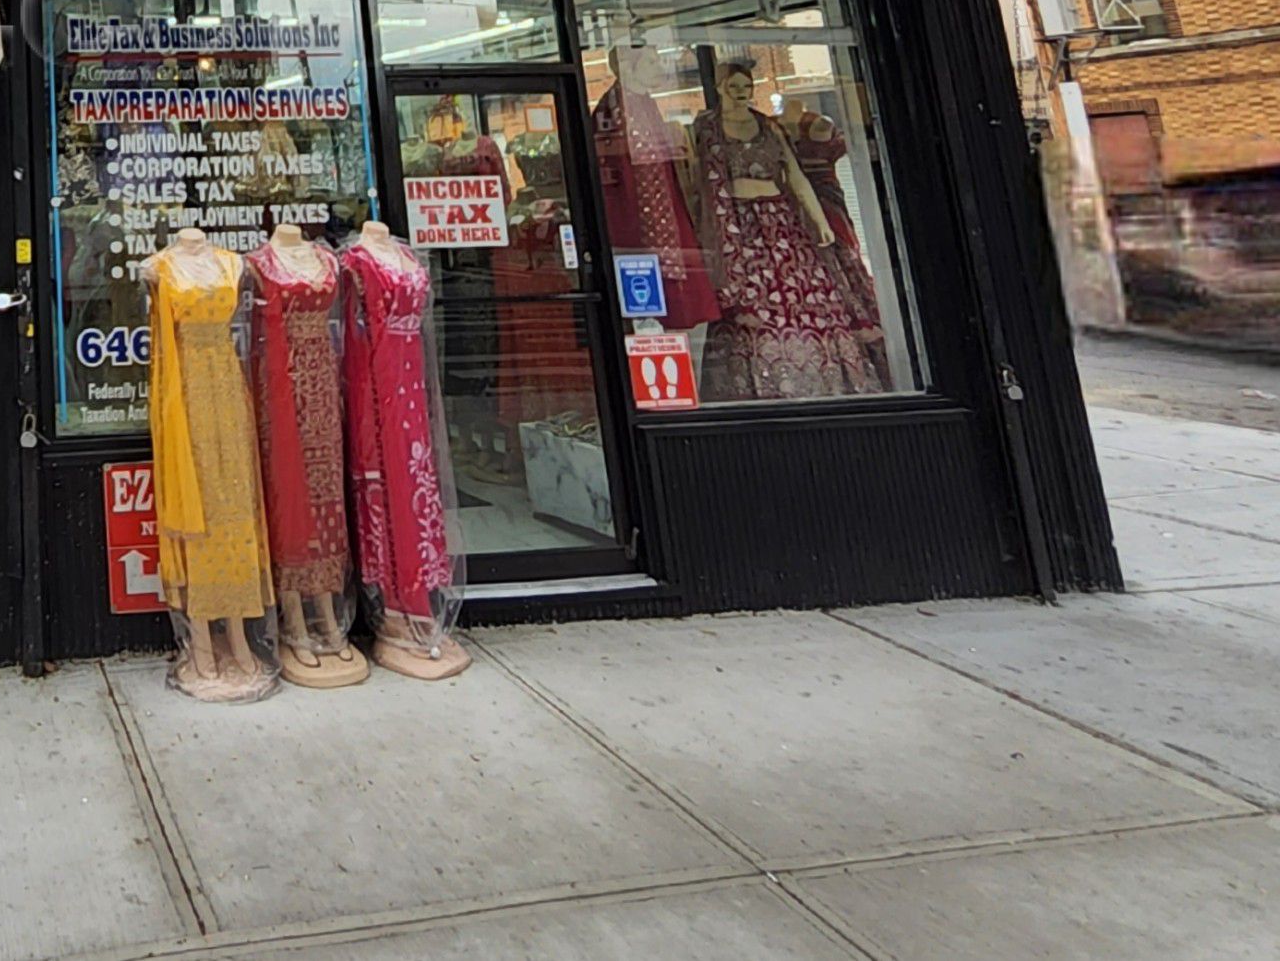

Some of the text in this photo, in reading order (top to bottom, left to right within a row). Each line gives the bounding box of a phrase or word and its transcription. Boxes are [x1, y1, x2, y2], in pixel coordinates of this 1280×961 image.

[68, 14, 341, 53] Elite Tax & Business Solutions Inc
[71, 86, 349, 122] TAX PREPARATION SERVICES
[120, 130, 261, 155] INDIVIDUAL TAXES
[121, 154, 324, 179] CORPORATION TAXES
[122, 181, 235, 204] SALES TAX
[407, 180, 499, 200] INCOME
[270, 204, 330, 224] TAXES
[420, 204, 492, 225] TAX
[126, 234, 157, 255] TAX
[416, 227, 501, 244] DONE HERE
[111, 469, 153, 513] EZ
